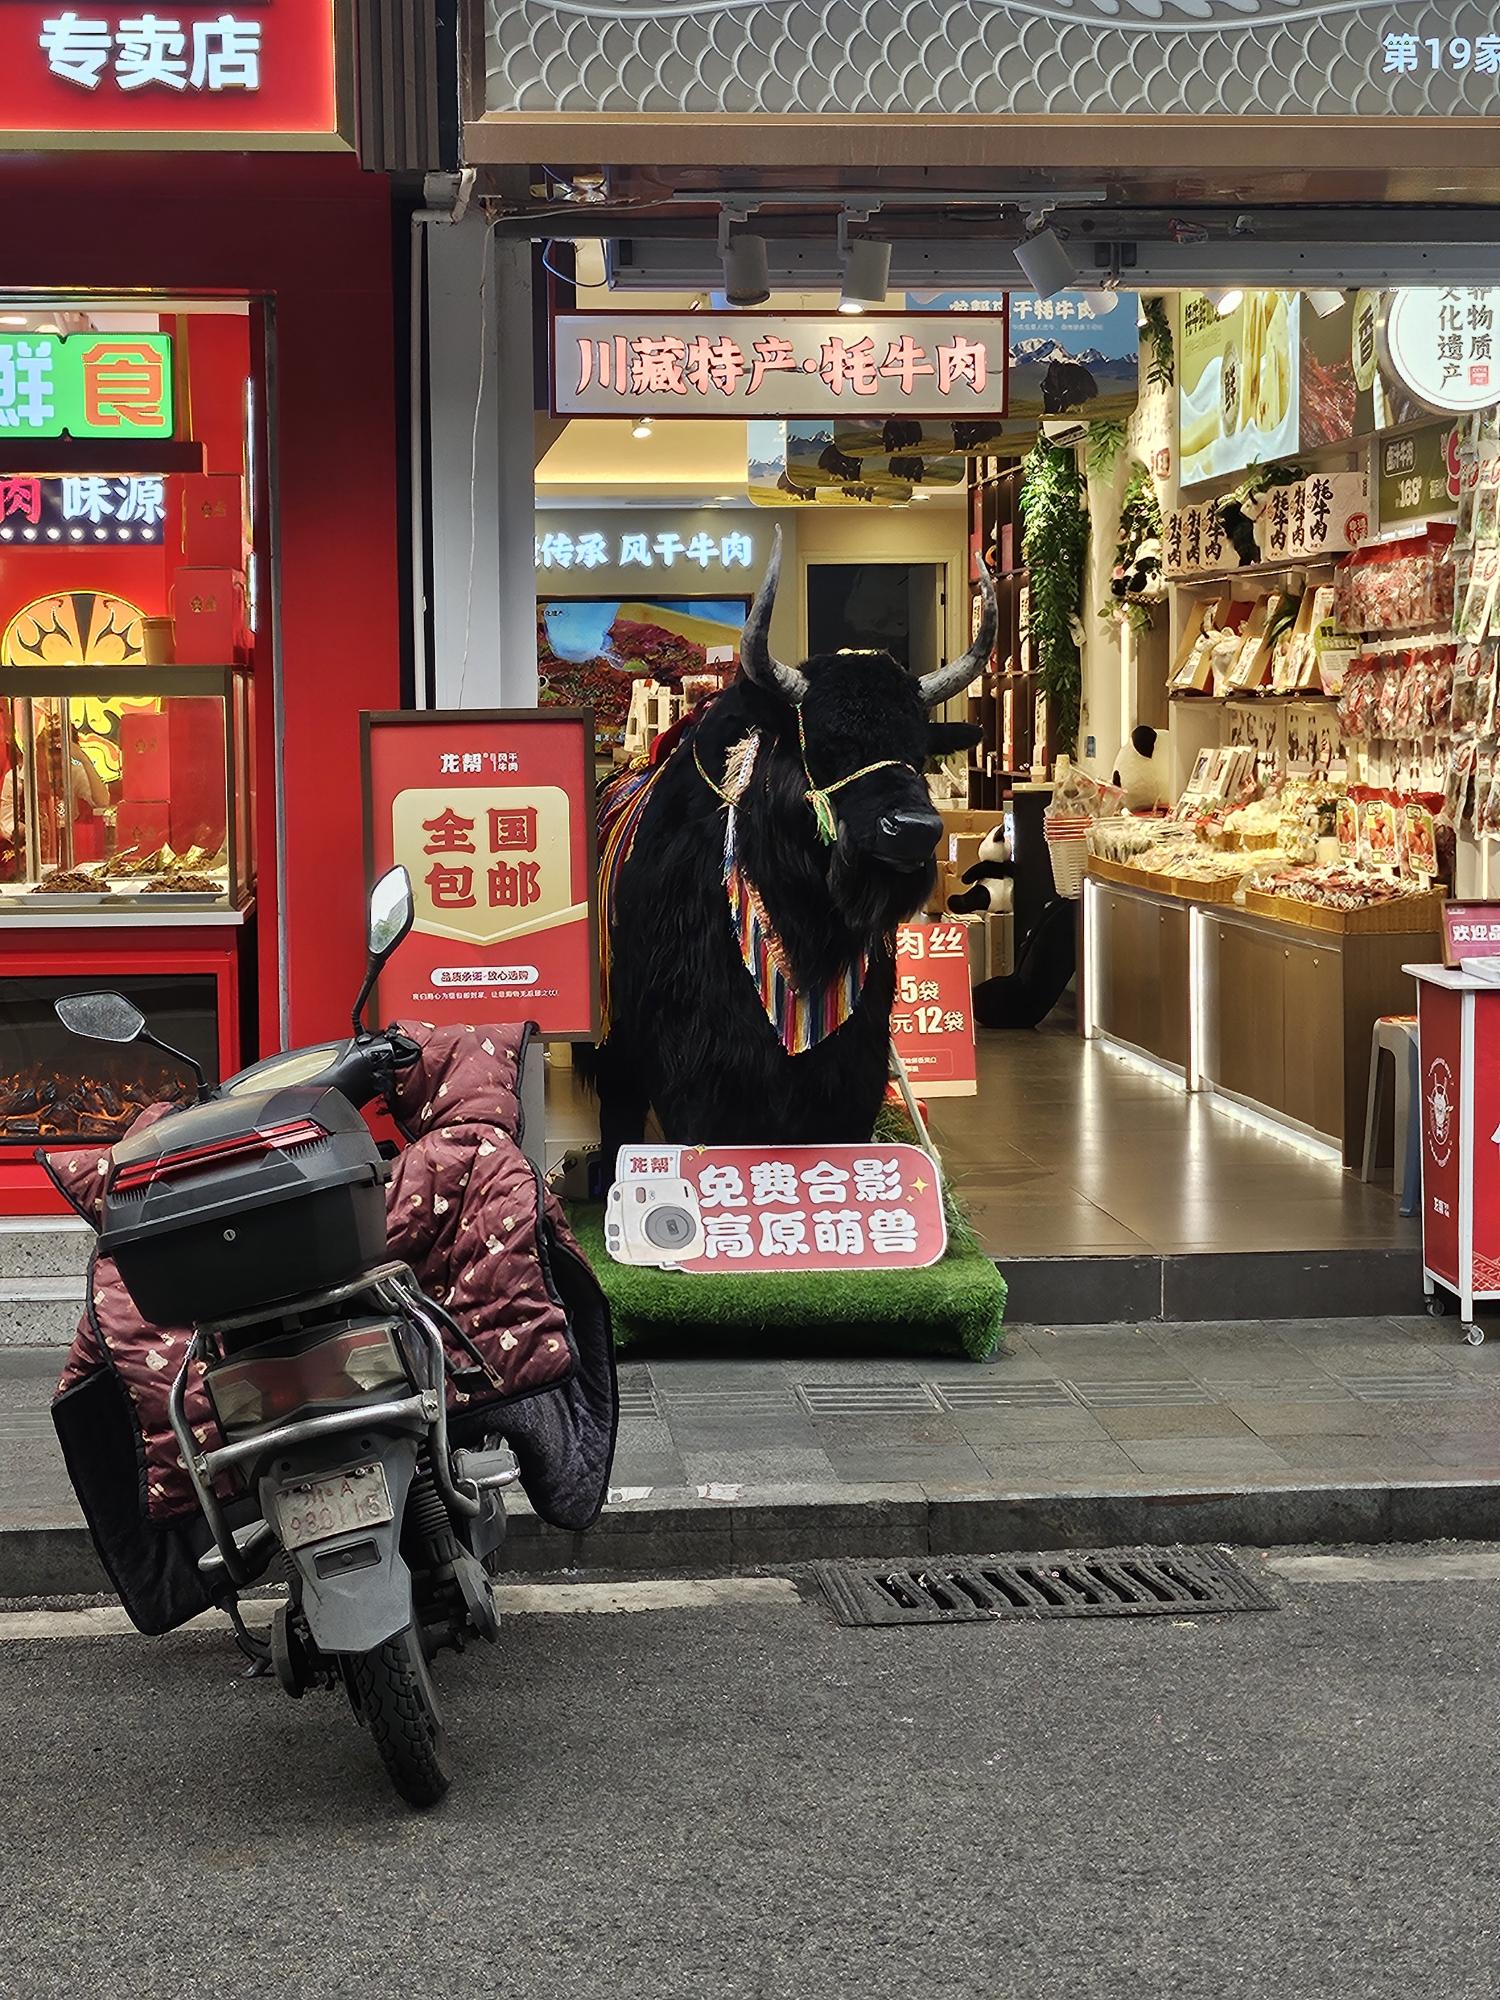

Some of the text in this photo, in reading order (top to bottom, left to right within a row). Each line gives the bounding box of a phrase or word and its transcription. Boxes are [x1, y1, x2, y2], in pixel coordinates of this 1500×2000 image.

[39, 13, 261, 91] 专卖店
[1382, 32, 1500, 73] 第19家
[0, 341, 164, 427] 鲜食
[61, 476, 166, 525] 味源
[1270, 490, 1289, 551] 牦牛肉
[1310, 478, 1334, 543] 牦牛肉
[535, 532, 752, 569] 传承 风干牛肉
[422, 806, 539, 856] 全国
[424, 860, 542, 909] 包邮
[699, 1158, 903, 1208] 免费合影
[701, 1208, 919, 1259] 高原萌兽
